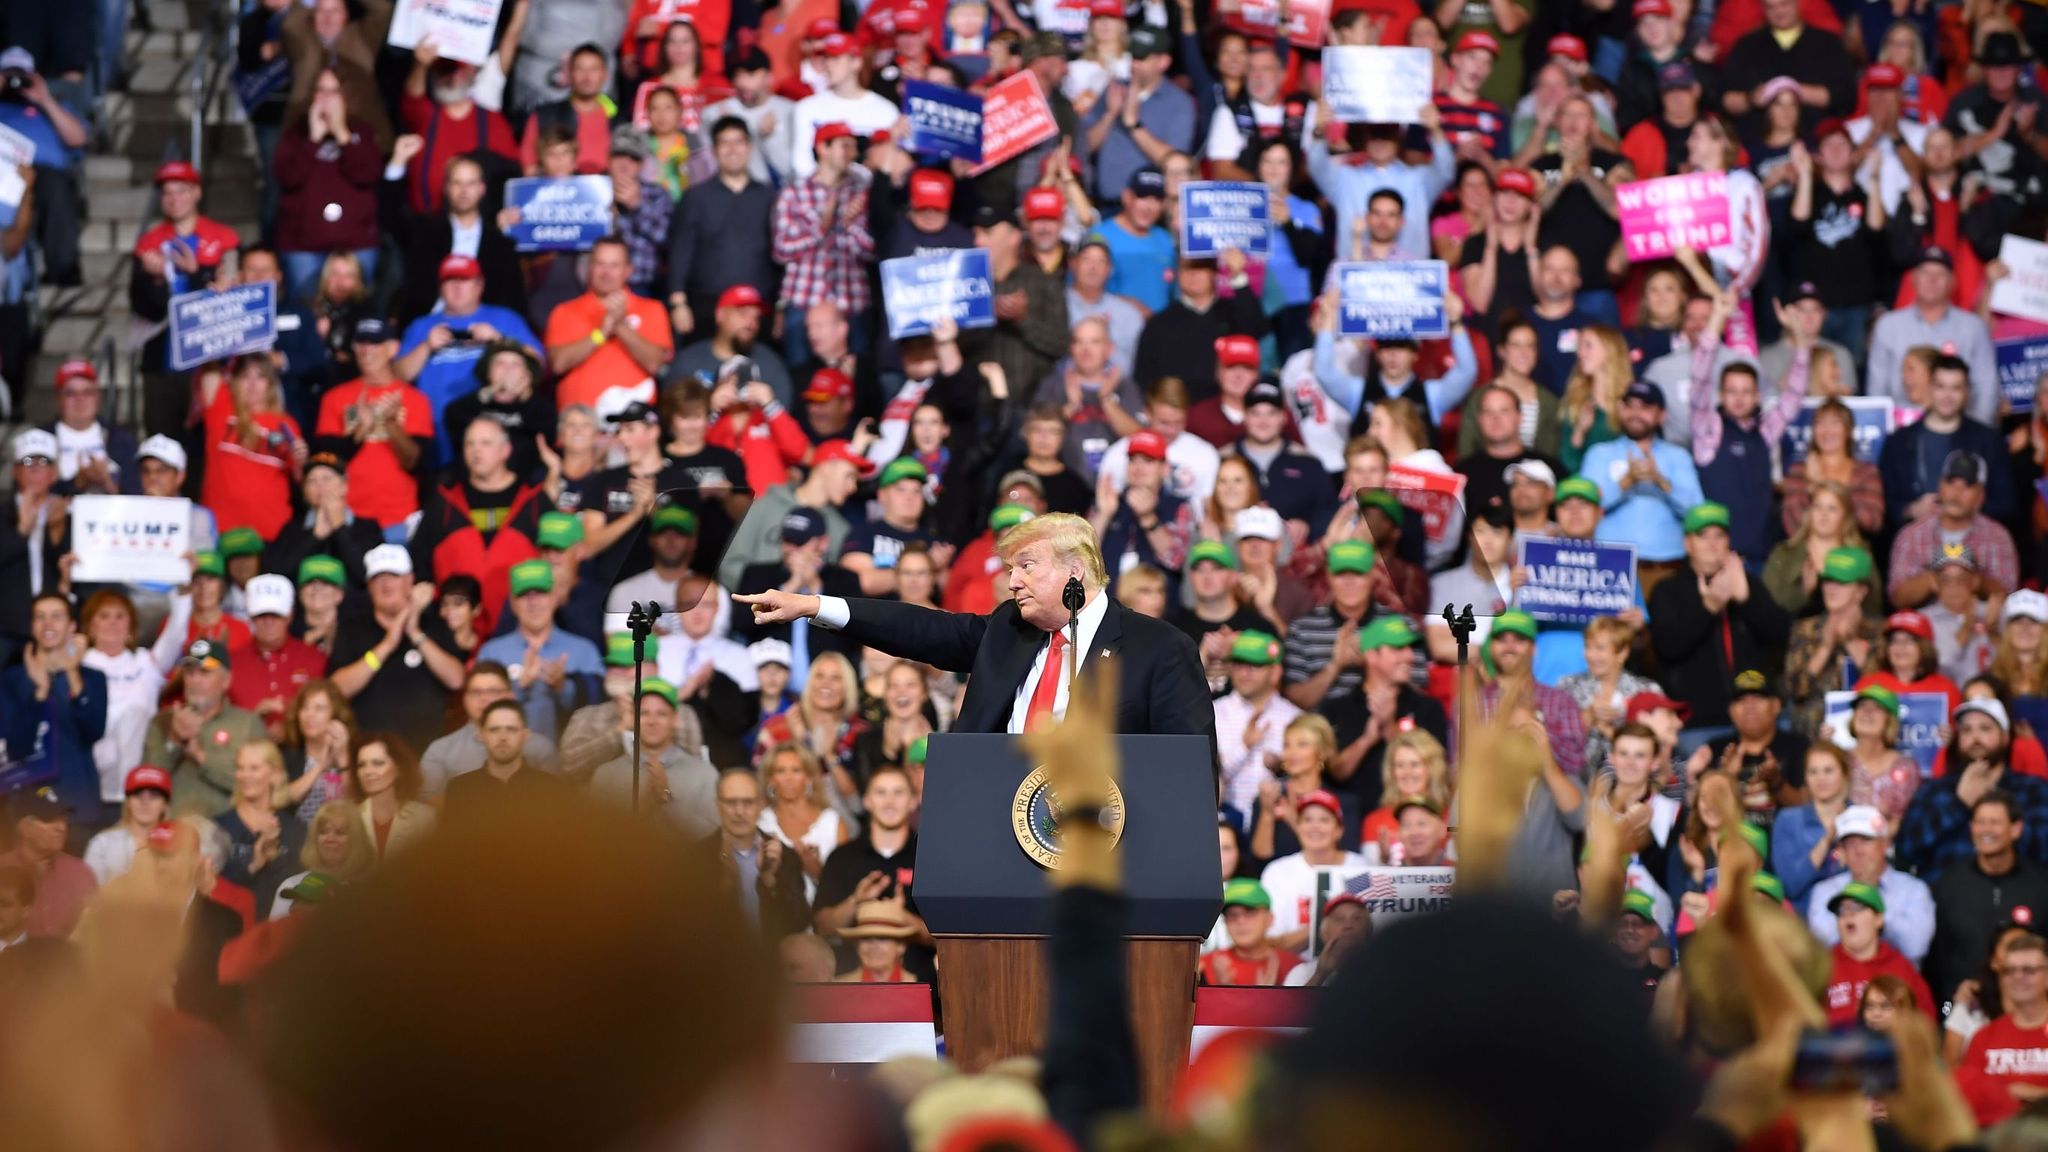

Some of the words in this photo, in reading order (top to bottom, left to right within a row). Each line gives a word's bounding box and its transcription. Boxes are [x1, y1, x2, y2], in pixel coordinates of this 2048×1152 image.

[909, 97, 982, 125] TRUMP
[1617, 176, 1727, 210] WOMEN
[1654, 205, 1696, 226] FOR
[532, 225, 582, 242] GREAT
[1629, 222, 1727, 255] TRUMP
[86, 521, 180, 535] TRUMP
[1556, 550, 1597, 567] MAKE
[1525, 564, 1631, 592] AMERICA
[1519, 586, 1580, 608] STRONG
[1581, 590, 1631, 610] AGAIN
[1016, 768, 1049, 813] PRESIDE
[1017, 817, 1026, 832] THE
[1022, 833, 1032, 844] OF
[1031, 845, 1060, 866] SEAL
[1390, 874, 1453, 884] VETERANS
[1366, 897, 1453, 913] TRUMP
[1984, 1048, 2048, 1067] TRUM
